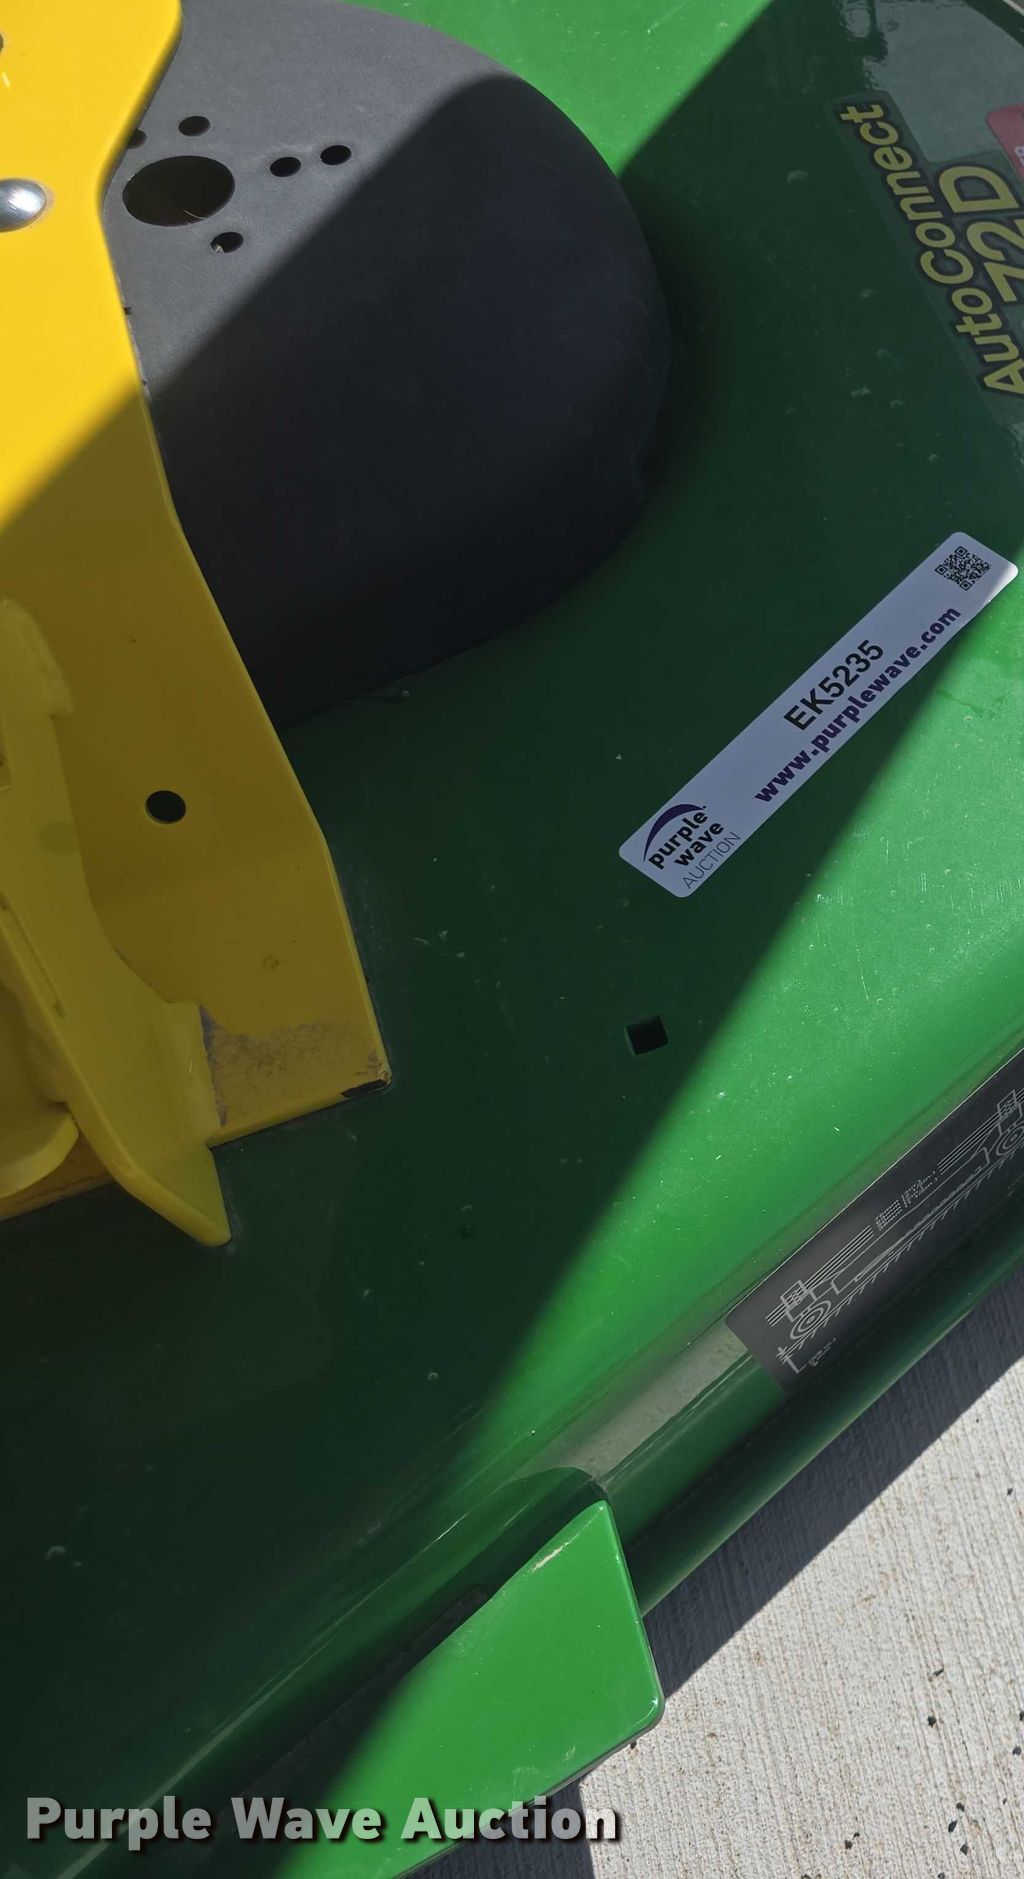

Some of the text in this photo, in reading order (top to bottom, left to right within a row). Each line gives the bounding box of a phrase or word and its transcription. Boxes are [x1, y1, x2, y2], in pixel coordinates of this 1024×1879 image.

[754, 607, 961, 803] www.purplewave.com
[783, 639, 884, 731] EK5235
[648, 808, 708, 870] purple
[674, 821, 724, 868] wave
[682, 831, 741, 889] AUCTION
